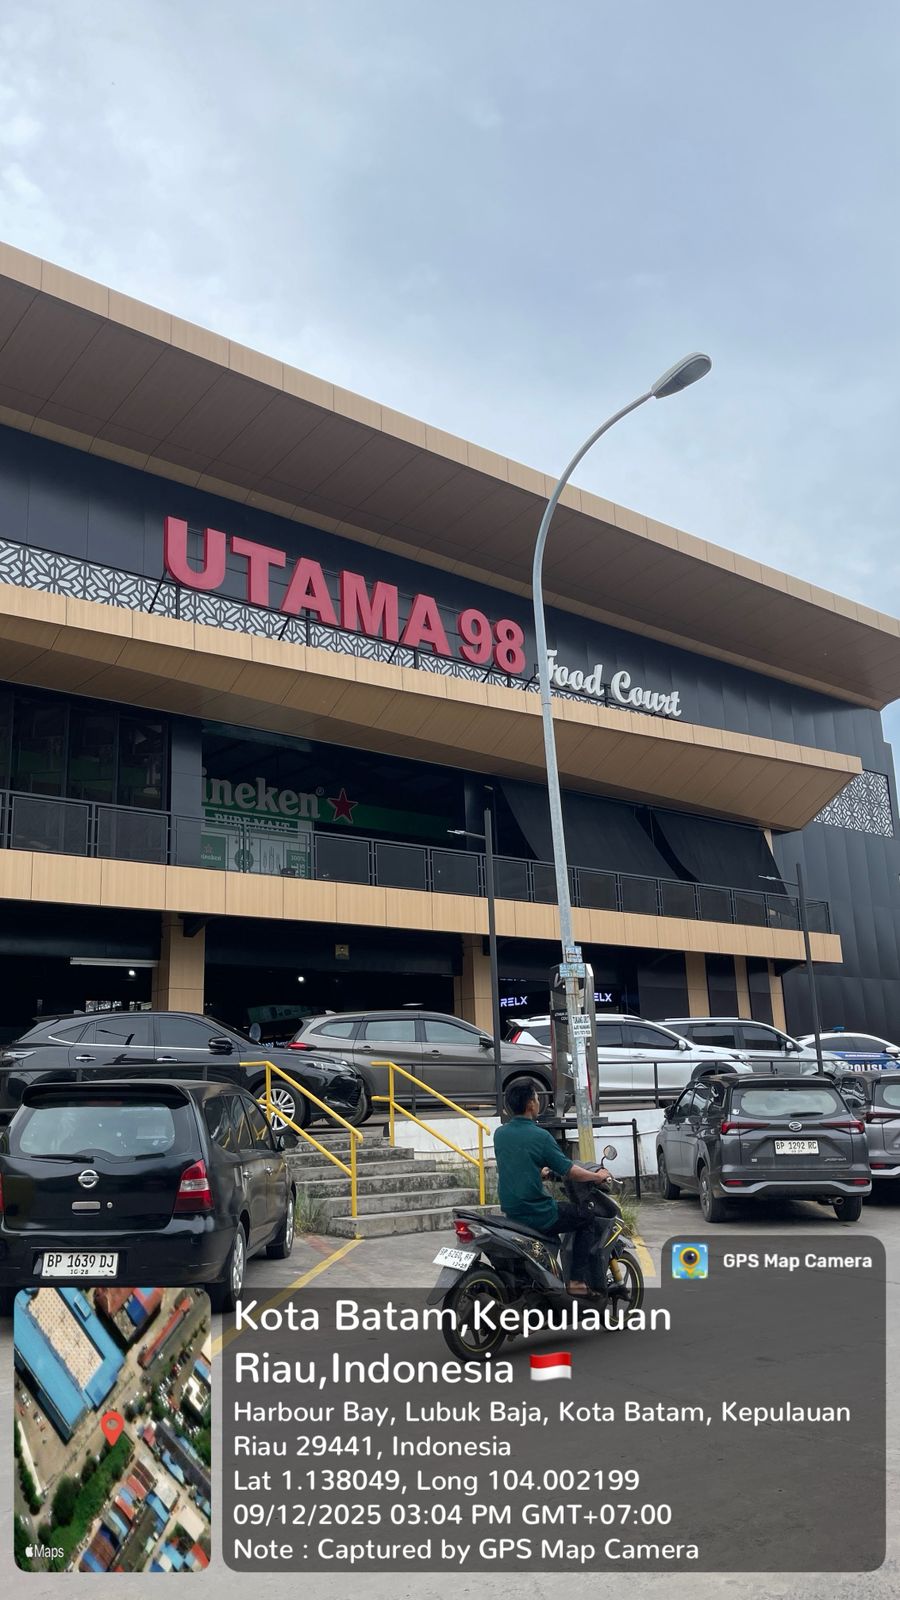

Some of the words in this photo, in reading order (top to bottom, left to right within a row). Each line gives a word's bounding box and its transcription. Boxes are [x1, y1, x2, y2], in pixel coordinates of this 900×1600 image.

[164, 515, 453, 656] UTAMA
[458, 608, 526, 674] 98
[536, 650, 604, 696] Food
[611, 670, 682, 716] Court
[500, 996, 528, 1008] RELX
[594, 992, 612, 1002] ELX
[788, 1141, 806, 1150] 1292
[47, 1254, 62, 1268] BP
[67, 1254, 96, 1268] 1639
[100, 1254, 115, 1268] DJ
